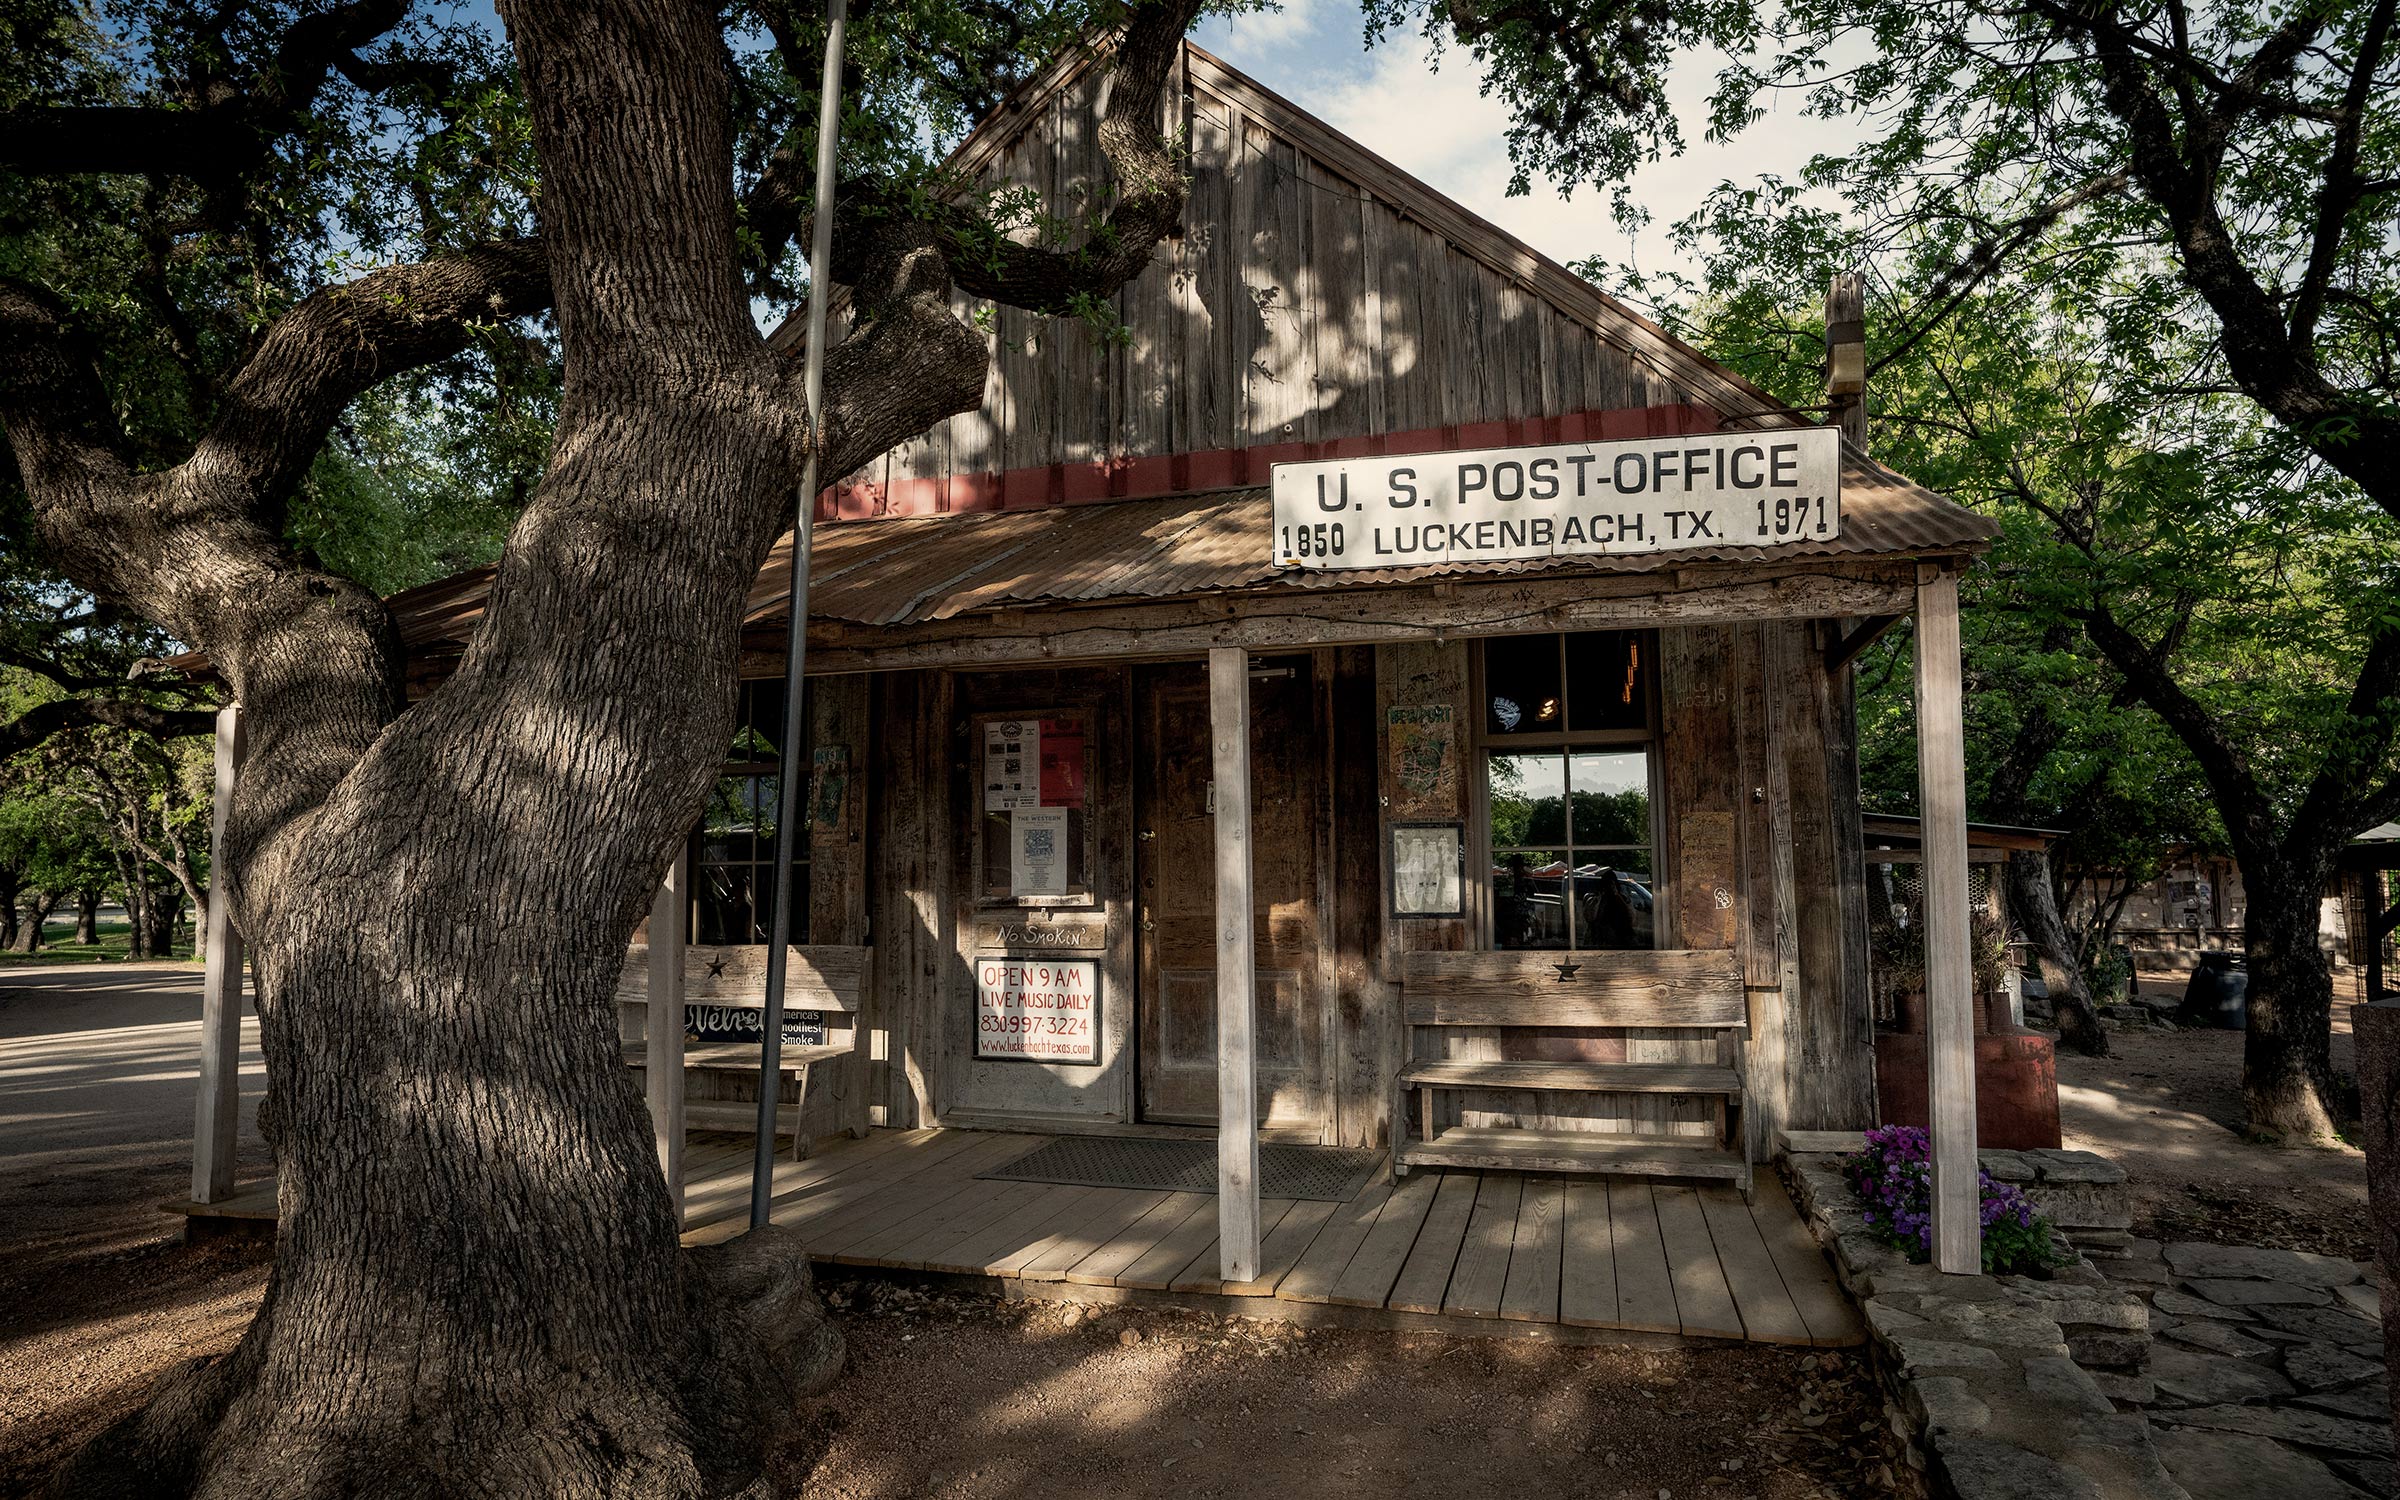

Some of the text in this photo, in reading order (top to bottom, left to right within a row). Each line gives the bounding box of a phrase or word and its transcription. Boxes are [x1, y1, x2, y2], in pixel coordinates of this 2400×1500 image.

[1317, 443, 1799, 513] U. S. POST-OFFICE
[1281, 522, 1345, 558] 1850
[1756, 496, 1828, 536] 1971
[984, 967, 1082, 988] OPEN 9 AM
[981, 991, 1092, 1010] LIVE MUSIC DAILY
[783, 1010, 820, 1020] merica's
[782, 1021, 822, 1033] moothest
[780, 1033, 814, 1046] Smoke
